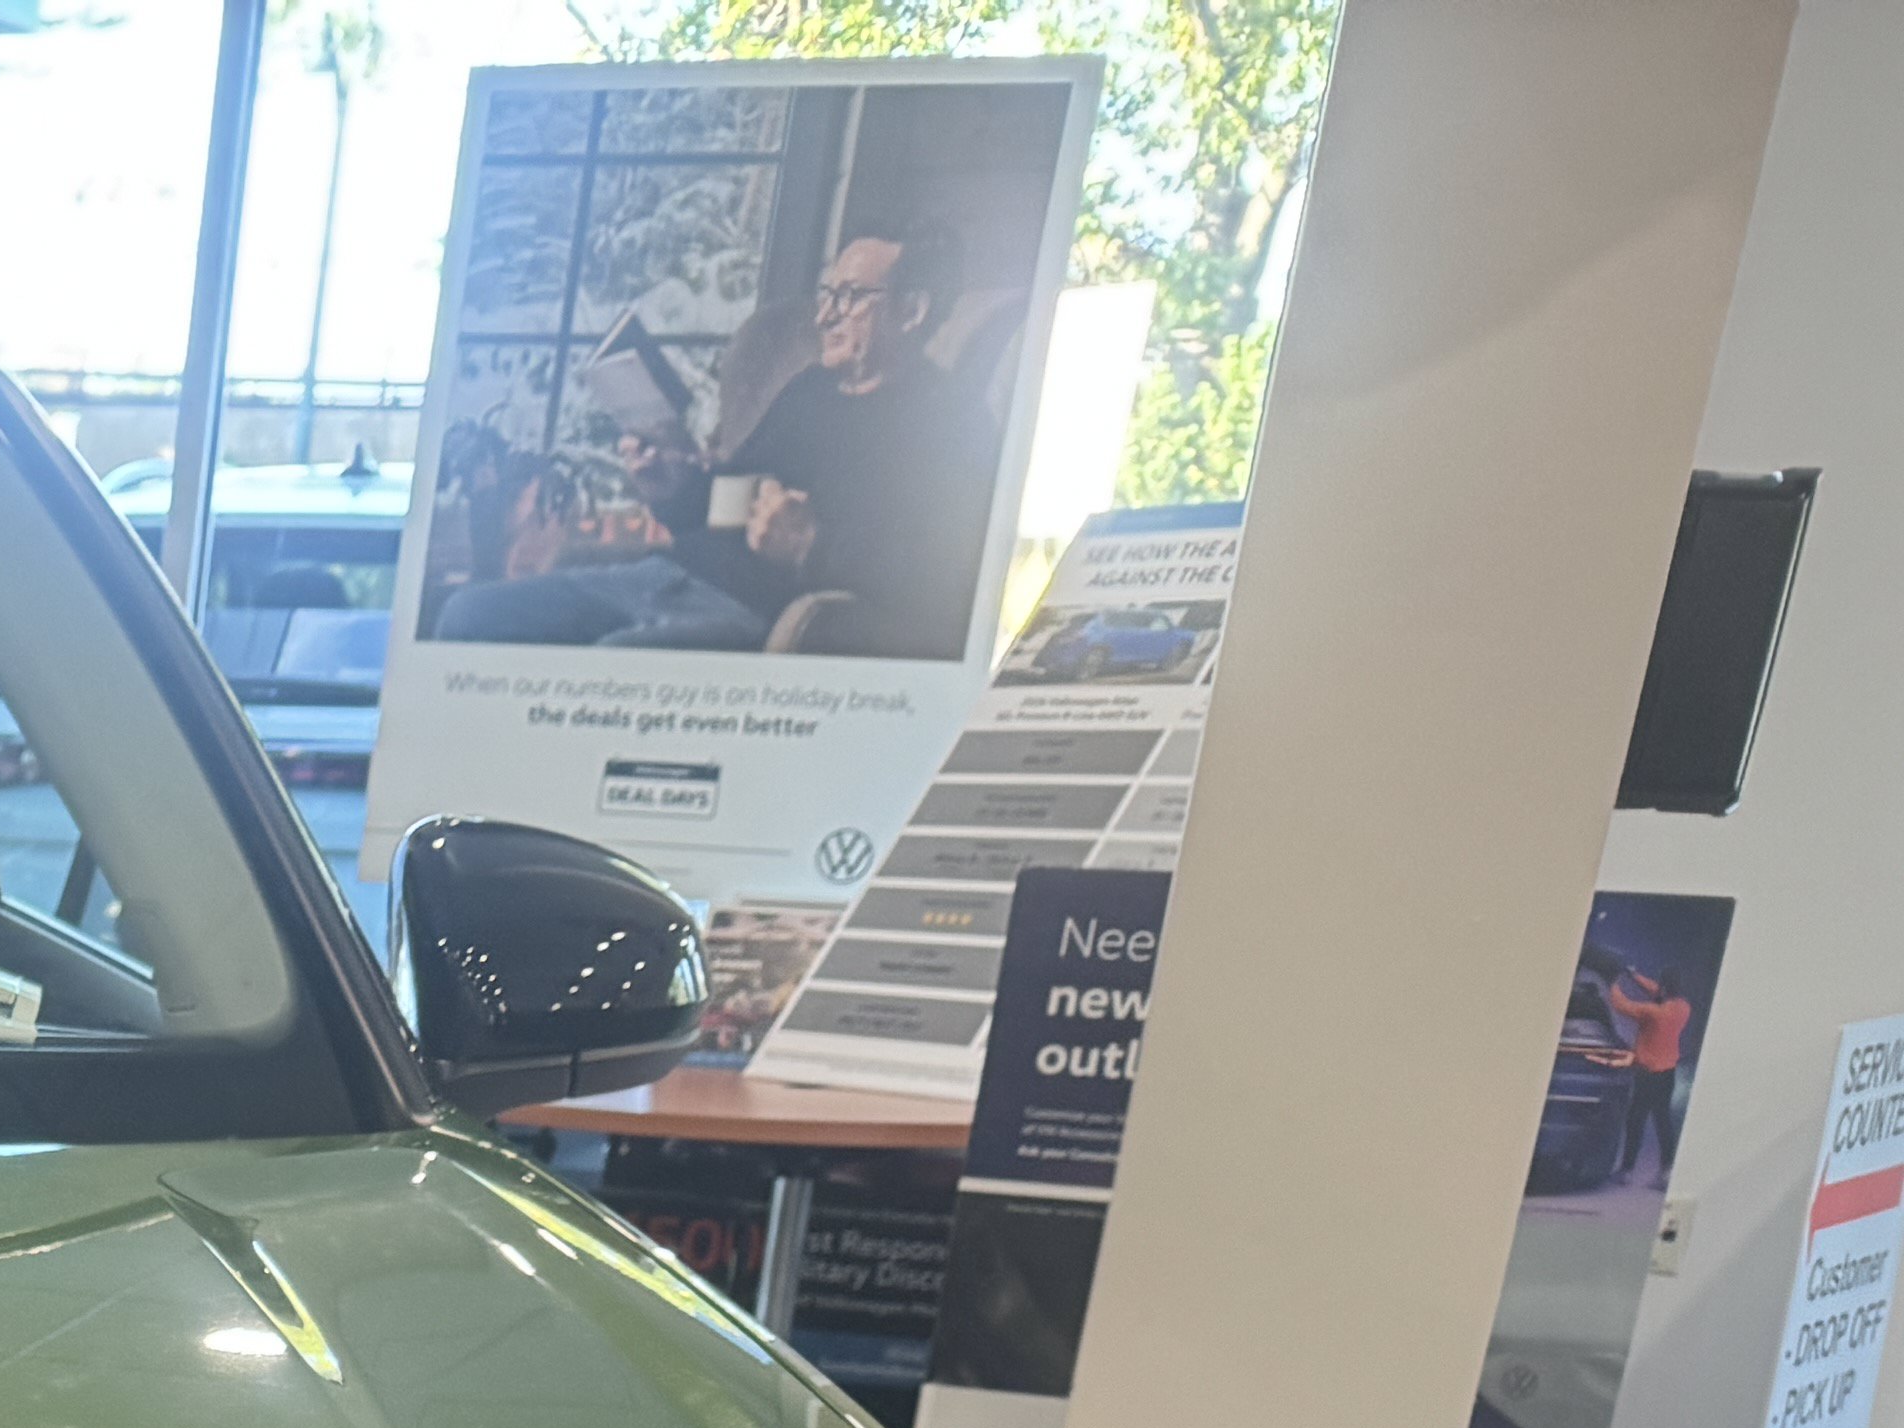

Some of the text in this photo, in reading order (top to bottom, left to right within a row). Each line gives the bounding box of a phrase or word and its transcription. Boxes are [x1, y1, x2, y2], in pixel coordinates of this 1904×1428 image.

[1179, 540, 1222, 559] THE
[1085, 567, 1177, 587] AGAINST
[1178, 564, 1222, 583] THE
[446, 672, 510, 694] When
[512, 677, 550, 698] our
[554, 677, 651, 699] numbers
[655, 683, 698, 709] guy
[702, 683, 720, 704] is
[725, 685, 757, 706] on
[761, 682, 844, 715] holiday
[528, 703, 818, 736] the deals get even better
[1058, 916, 1156, 962] Nee
[1806, 1249, 1889, 1302] Customer
[1793, 1299, 1887, 1367] DROP OFF
[1827, 1368, 1856, 1416] UP
